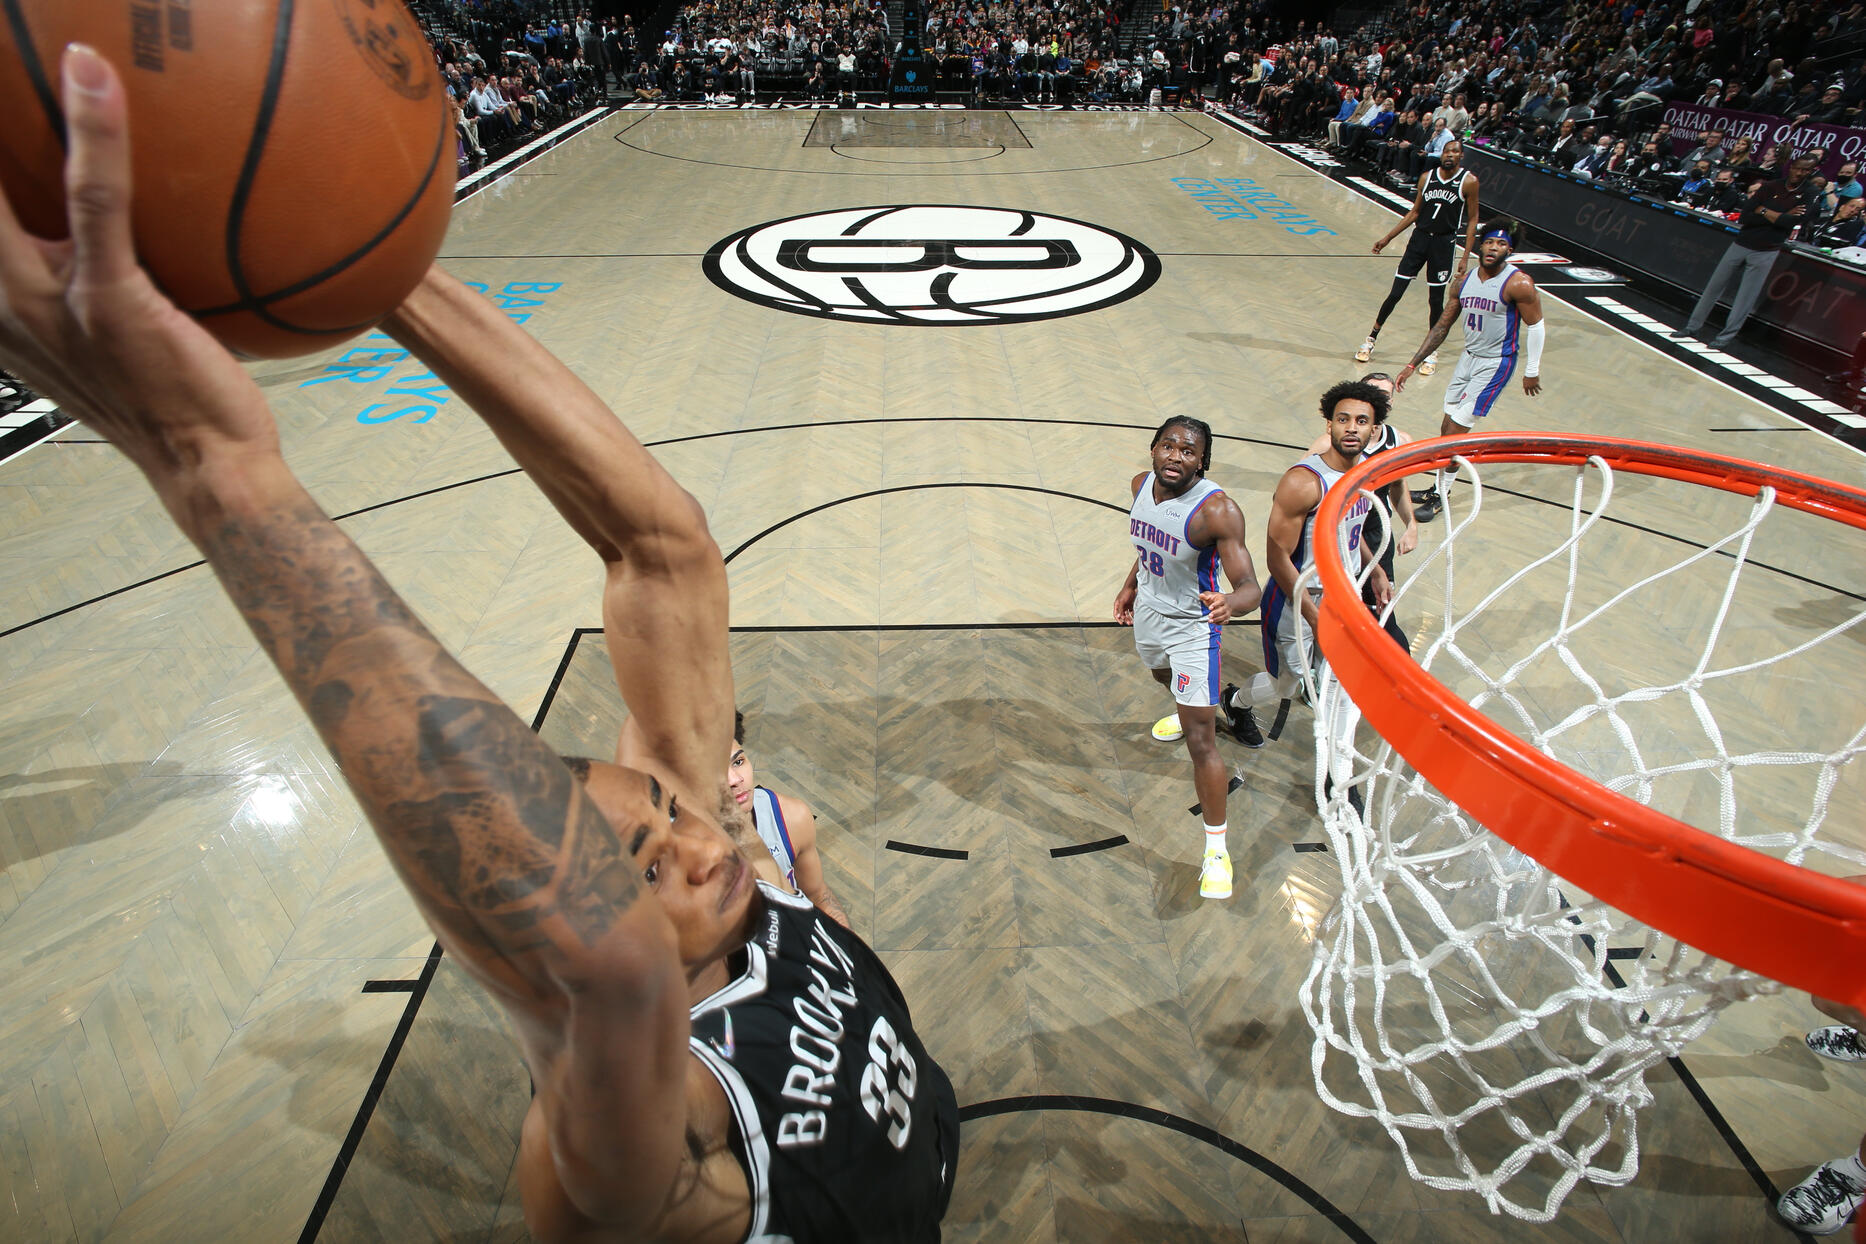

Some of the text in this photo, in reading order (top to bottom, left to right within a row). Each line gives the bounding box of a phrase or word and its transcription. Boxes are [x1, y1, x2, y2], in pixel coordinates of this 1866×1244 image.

[894, 85, 929, 93] BARCLAYS
[621, 102, 839, 110] Brooklyn
[1663, 107, 1711, 131] QATAR
[1773, 124, 1837, 149] QATAR
[1169, 177, 1259, 221] CENTER
[1214, 177, 1340, 236] BARCLAYS
[1424, 189, 1458, 204] BROOKLYN
[1431, 203, 1442, 220] 7
[1575, 202, 1648, 244] GOAT
[1460, 296, 1499, 313] DETROIT
[1767, 270, 1857, 320] OAT
[1467, 312, 1484, 332] 41
[1130, 518, 1182, 556] DETROIT
[1348, 523, 1362, 551] 8
[1136, 544, 1165, 578] 28
[767, 909, 780, 958] Webull
[859, 1015, 918, 1149] 33
